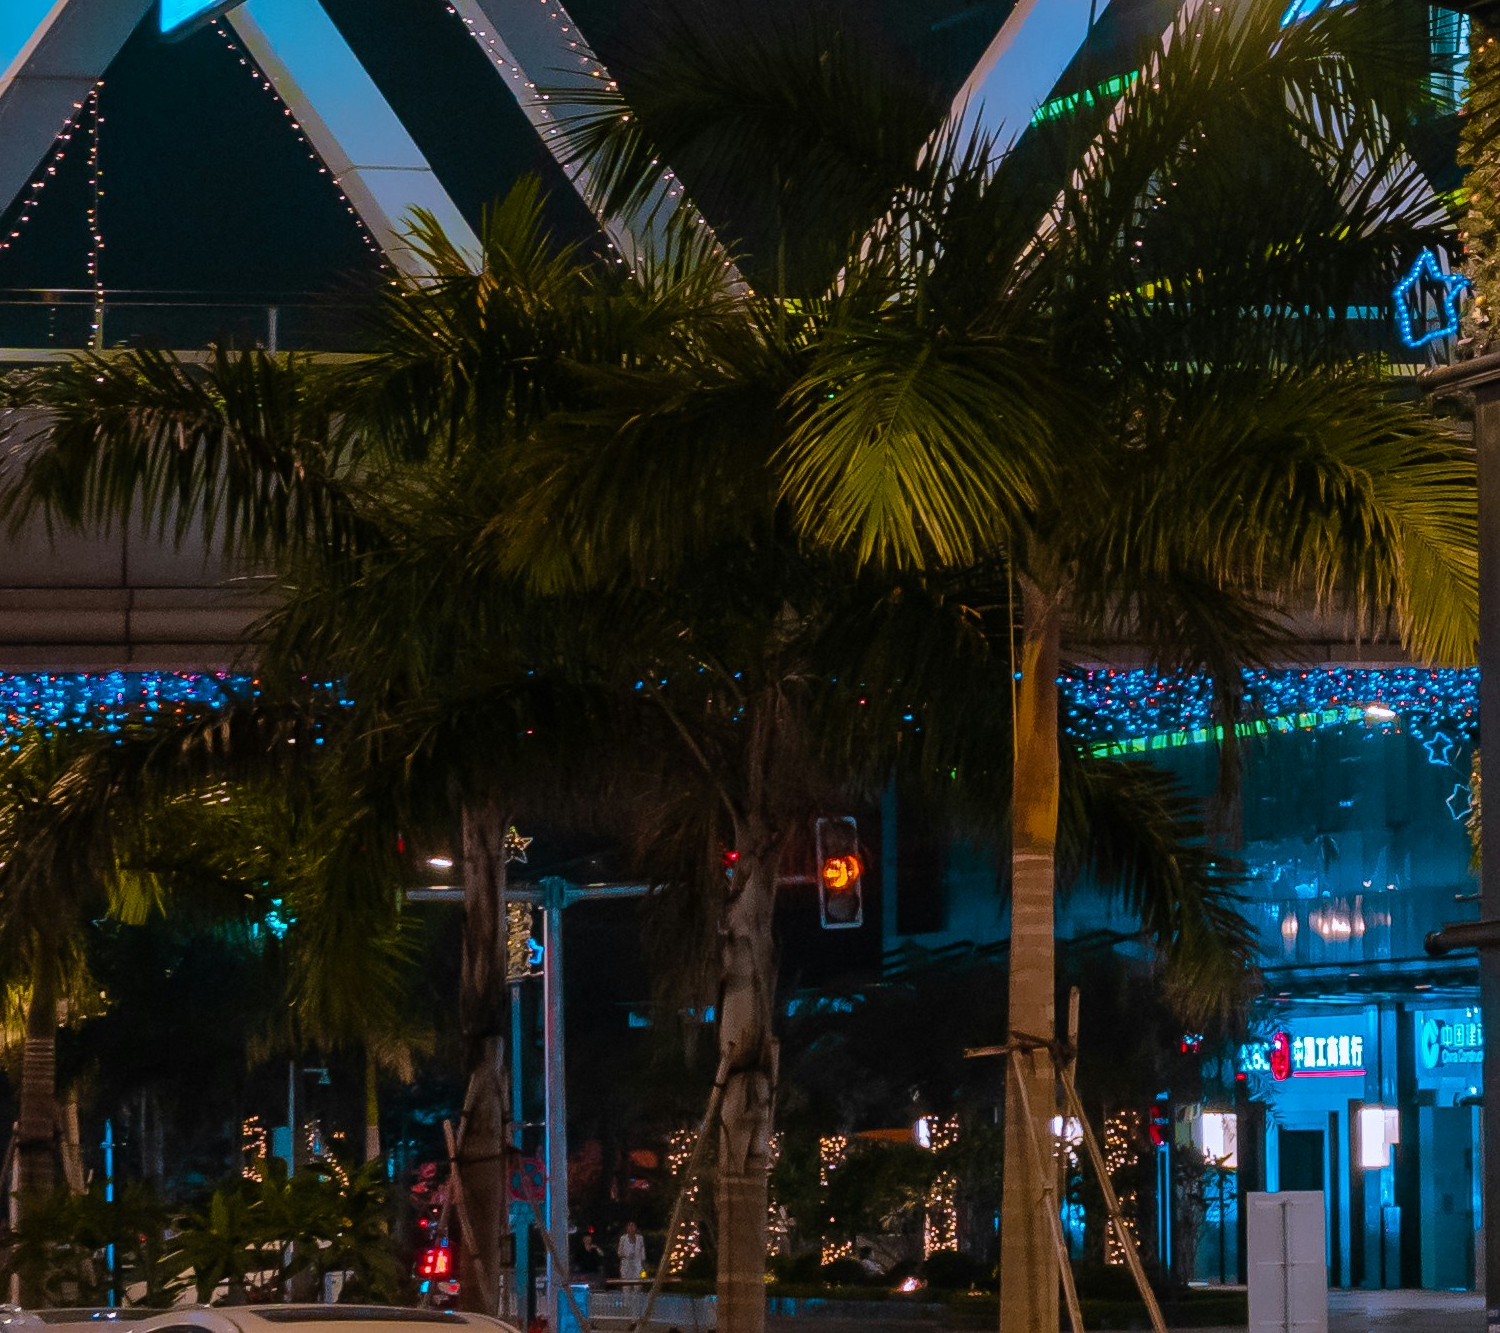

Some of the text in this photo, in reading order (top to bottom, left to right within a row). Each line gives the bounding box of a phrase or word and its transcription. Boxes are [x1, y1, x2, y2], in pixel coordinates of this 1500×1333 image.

[1293, 1035, 1363, 1068] 中国工商银行
